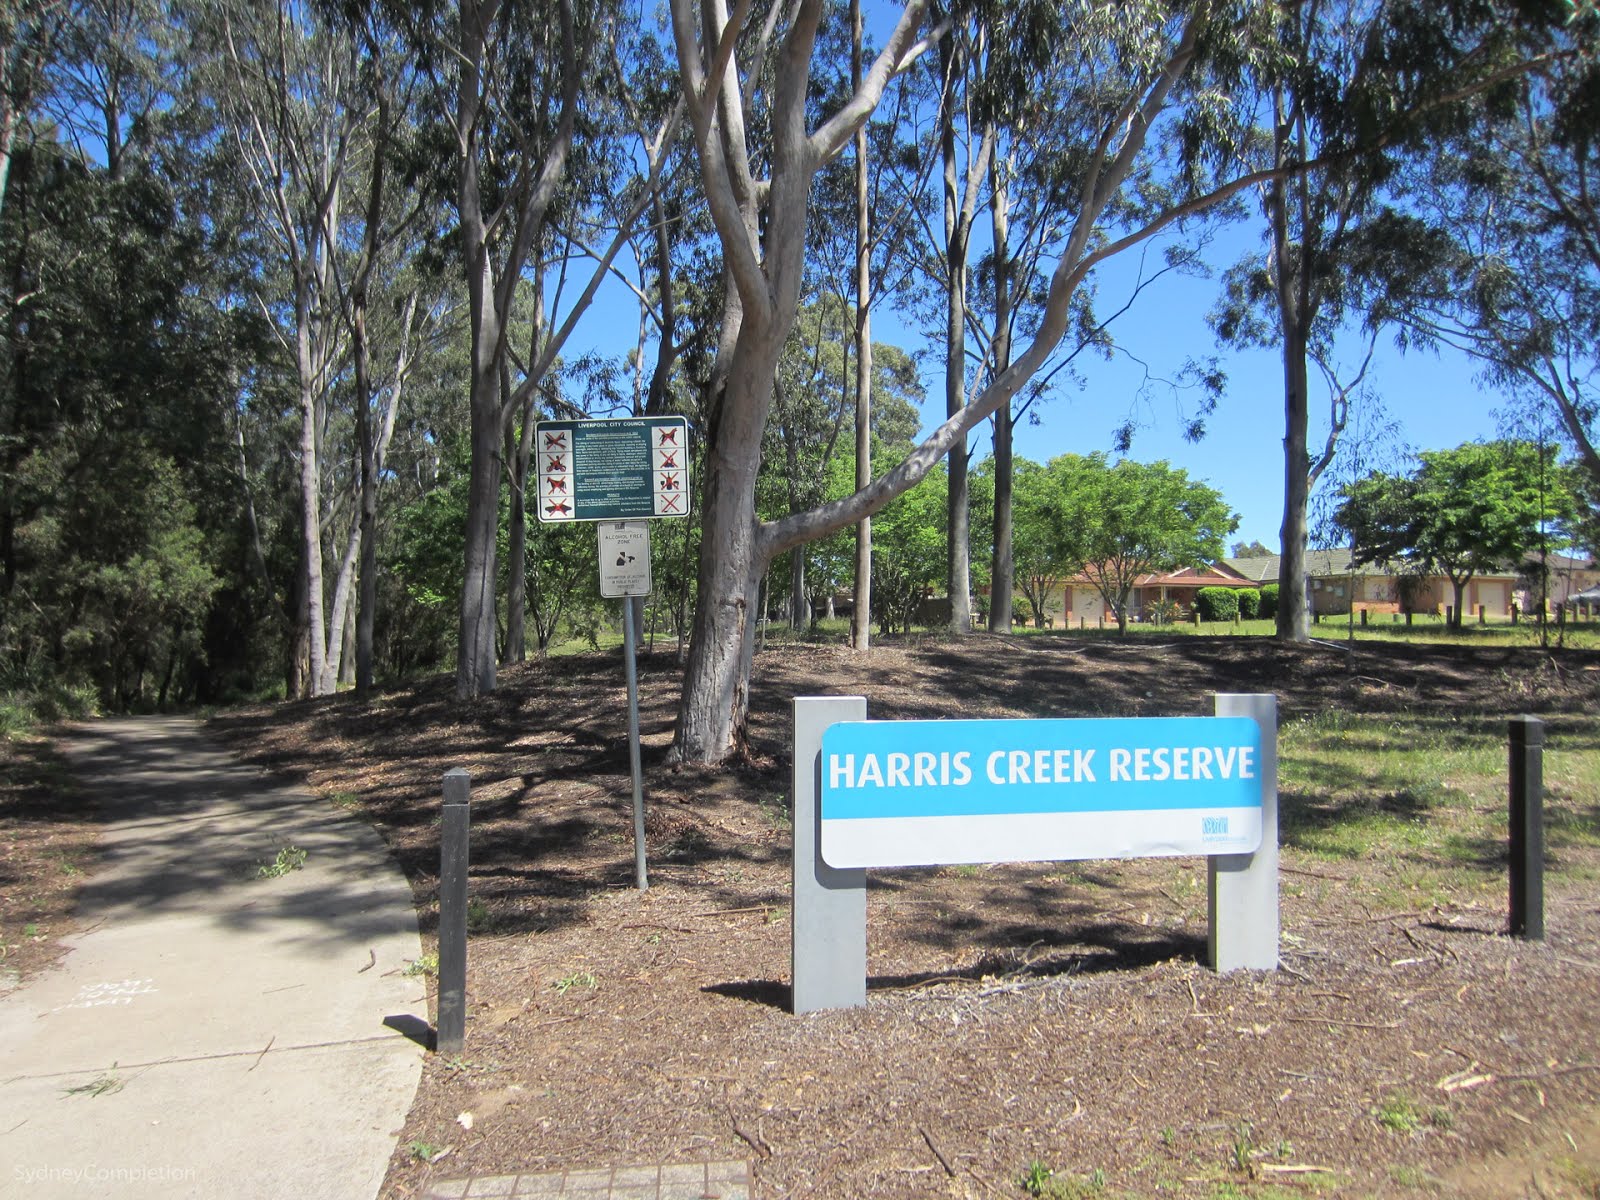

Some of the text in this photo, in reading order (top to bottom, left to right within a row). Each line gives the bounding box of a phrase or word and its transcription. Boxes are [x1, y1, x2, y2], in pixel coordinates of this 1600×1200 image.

[829, 746, 1254, 789] HARRIS CREEK RESERVE
